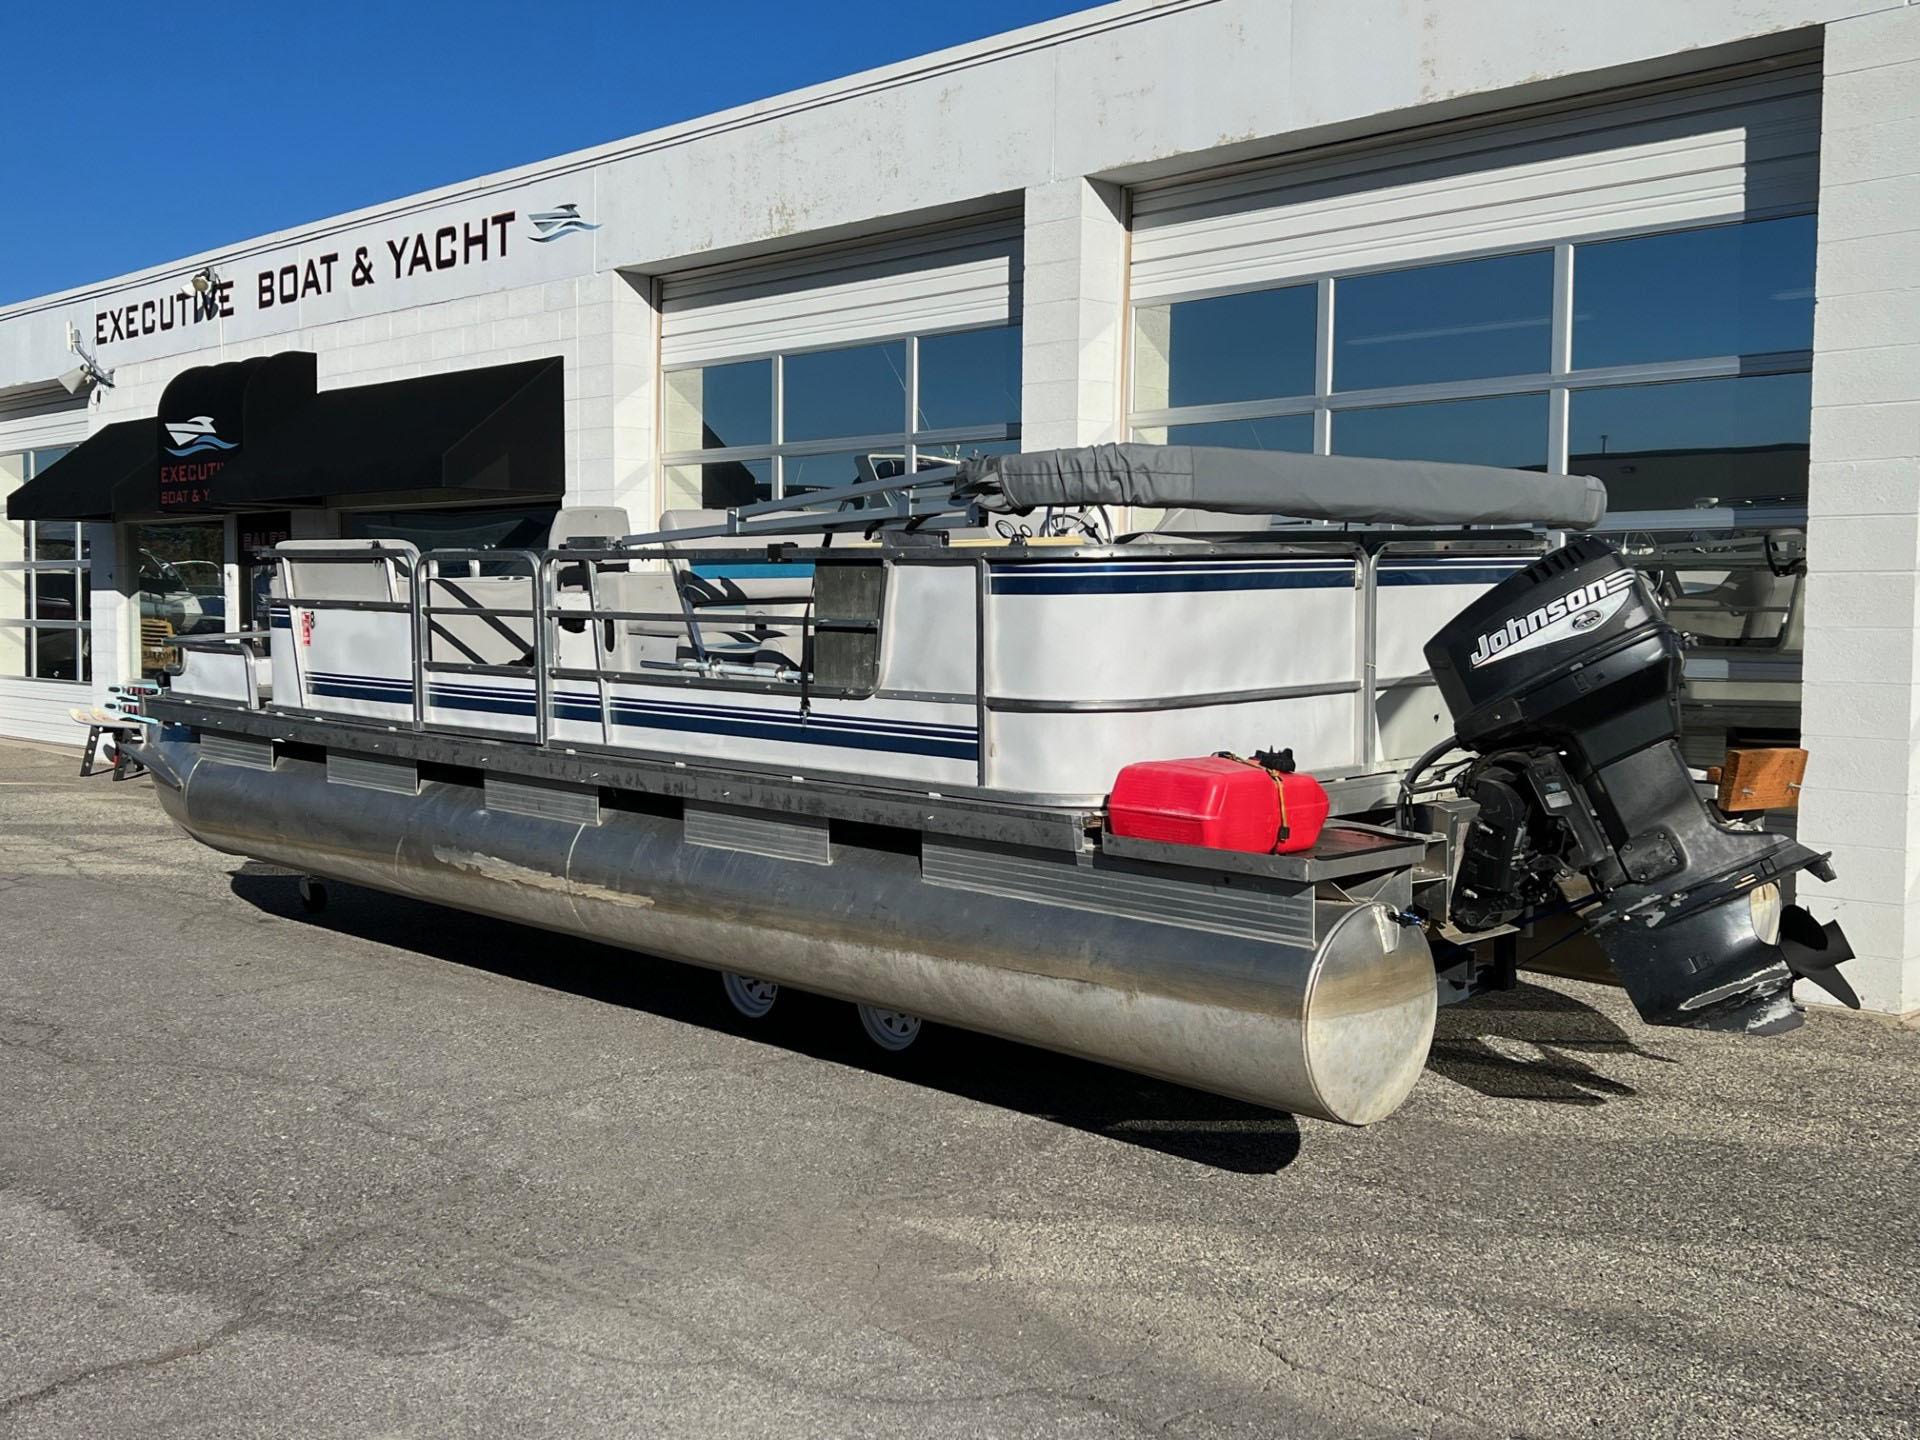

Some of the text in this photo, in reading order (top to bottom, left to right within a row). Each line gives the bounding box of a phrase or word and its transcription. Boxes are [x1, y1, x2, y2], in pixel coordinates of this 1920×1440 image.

[258, 252, 338, 309] BOAT
[351, 246, 375, 287] &
[386, 211, 516, 279] YACHT
[161, 491, 188, 504] BOAT
[191, 489, 201, 503] &
[1471, 575, 1618, 664] Johnson
